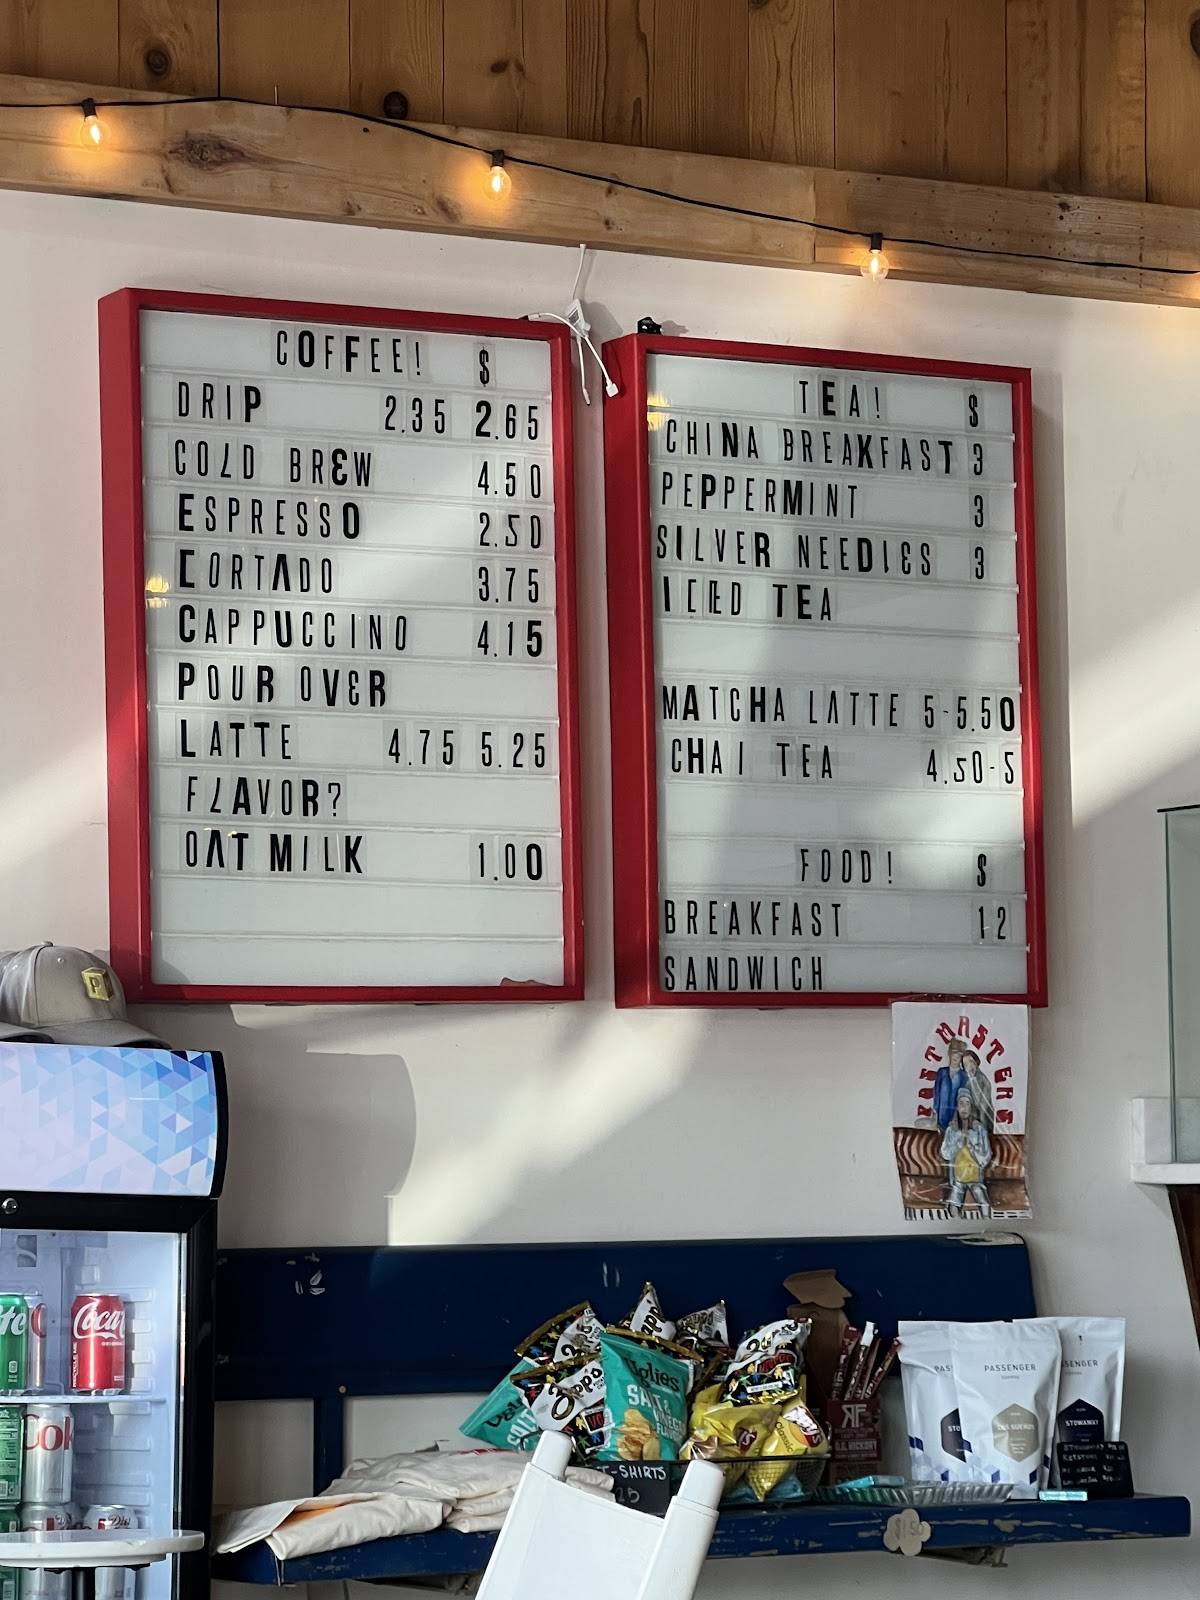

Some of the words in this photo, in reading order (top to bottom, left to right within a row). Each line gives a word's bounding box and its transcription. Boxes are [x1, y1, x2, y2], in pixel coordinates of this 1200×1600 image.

[276, 330, 422, 376] COFFEE!
[178, 381, 262, 423] DRIP
[384, 394, 446, 435] 2.35
[475, 399, 539, 441] 2.65
[798, 380, 880, 419] TEA!
[174, 439, 255, 480] COLD
[289, 447, 372, 488] BREW
[477, 460, 542, 499] 4.50
[666, 418, 759, 460] CHINA
[782, 427, 953, 475] BREAKFAST
[972, 442, 984, 476] 3
[178, 492, 360, 540] ESPRESSO
[479, 511, 542, 550] 2.50
[661, 471, 858, 519] PEPPERMINT
[973, 494, 984, 529] 3
[656, 524, 771, 569] SILVER
[974, 546, 985, 580] 3
[178, 549, 333, 593] CORTADO
[478, 566, 539, 604] 3.75
[663, 575, 742, 619] ICED
[772, 583, 832, 621] TEA
[178, 603, 407, 652] CAPPUCCINO
[477, 619, 543, 658] 4.15
[178, 661, 275, 703] POUR
[300, 665, 386, 708] OVER
[662, 684, 785, 723] MATCHA
[809, 690, 899, 728] LATTE
[924, 694, 1015, 732] 5-5.50
[180, 718, 292, 760] LATTE
[388, 728, 454, 766] 4.75
[481, 731, 546, 769] 5.25
[671, 737, 744, 776] CHAI
[775, 742, 833, 779] TEA
[186, 775, 342, 817] FLAVOR?
[185, 829, 250, 871] OAT
[269, 833, 363, 874] MILK
[478, 842, 543, 882] 1.00
[800, 848, 893, 885] FOOD!
[664, 899, 841, 938] BREAKFAST
[978, 905, 1006, 940] 12
[664, 955, 825, 992] SANDWICH
[624, 1357, 681, 1393] Uglies
[984, 1363, 1037, 1372] PASSENGER
[775, 1420, 795, 1453] Classic
[597, 1464, 667, 1480] T-SHIRTS
